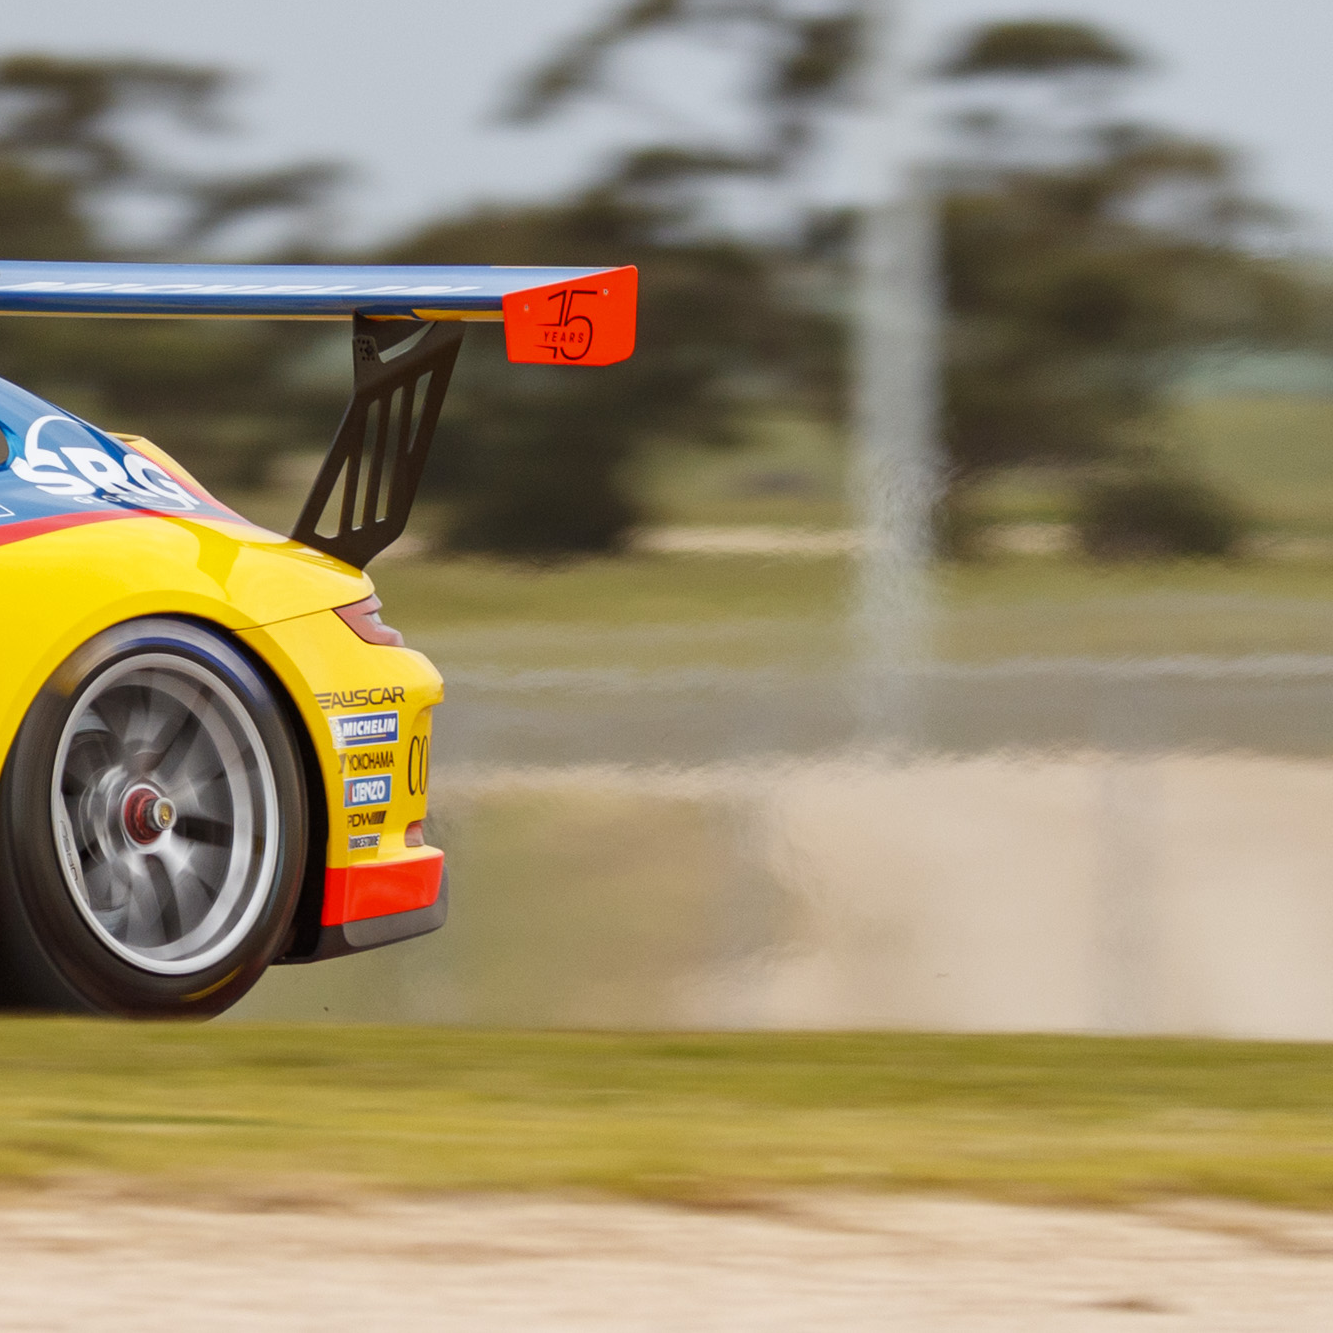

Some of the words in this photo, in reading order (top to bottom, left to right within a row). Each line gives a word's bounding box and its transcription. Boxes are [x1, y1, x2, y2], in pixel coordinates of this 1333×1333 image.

[536, 290, 598, 361] 15
[543, 331, 584, 343] YEARS
[10, 417, 200, 509] SRG
[342, 718, 396, 737] MICHELIN
[347, 751, 395, 771] YOKOHAMA
